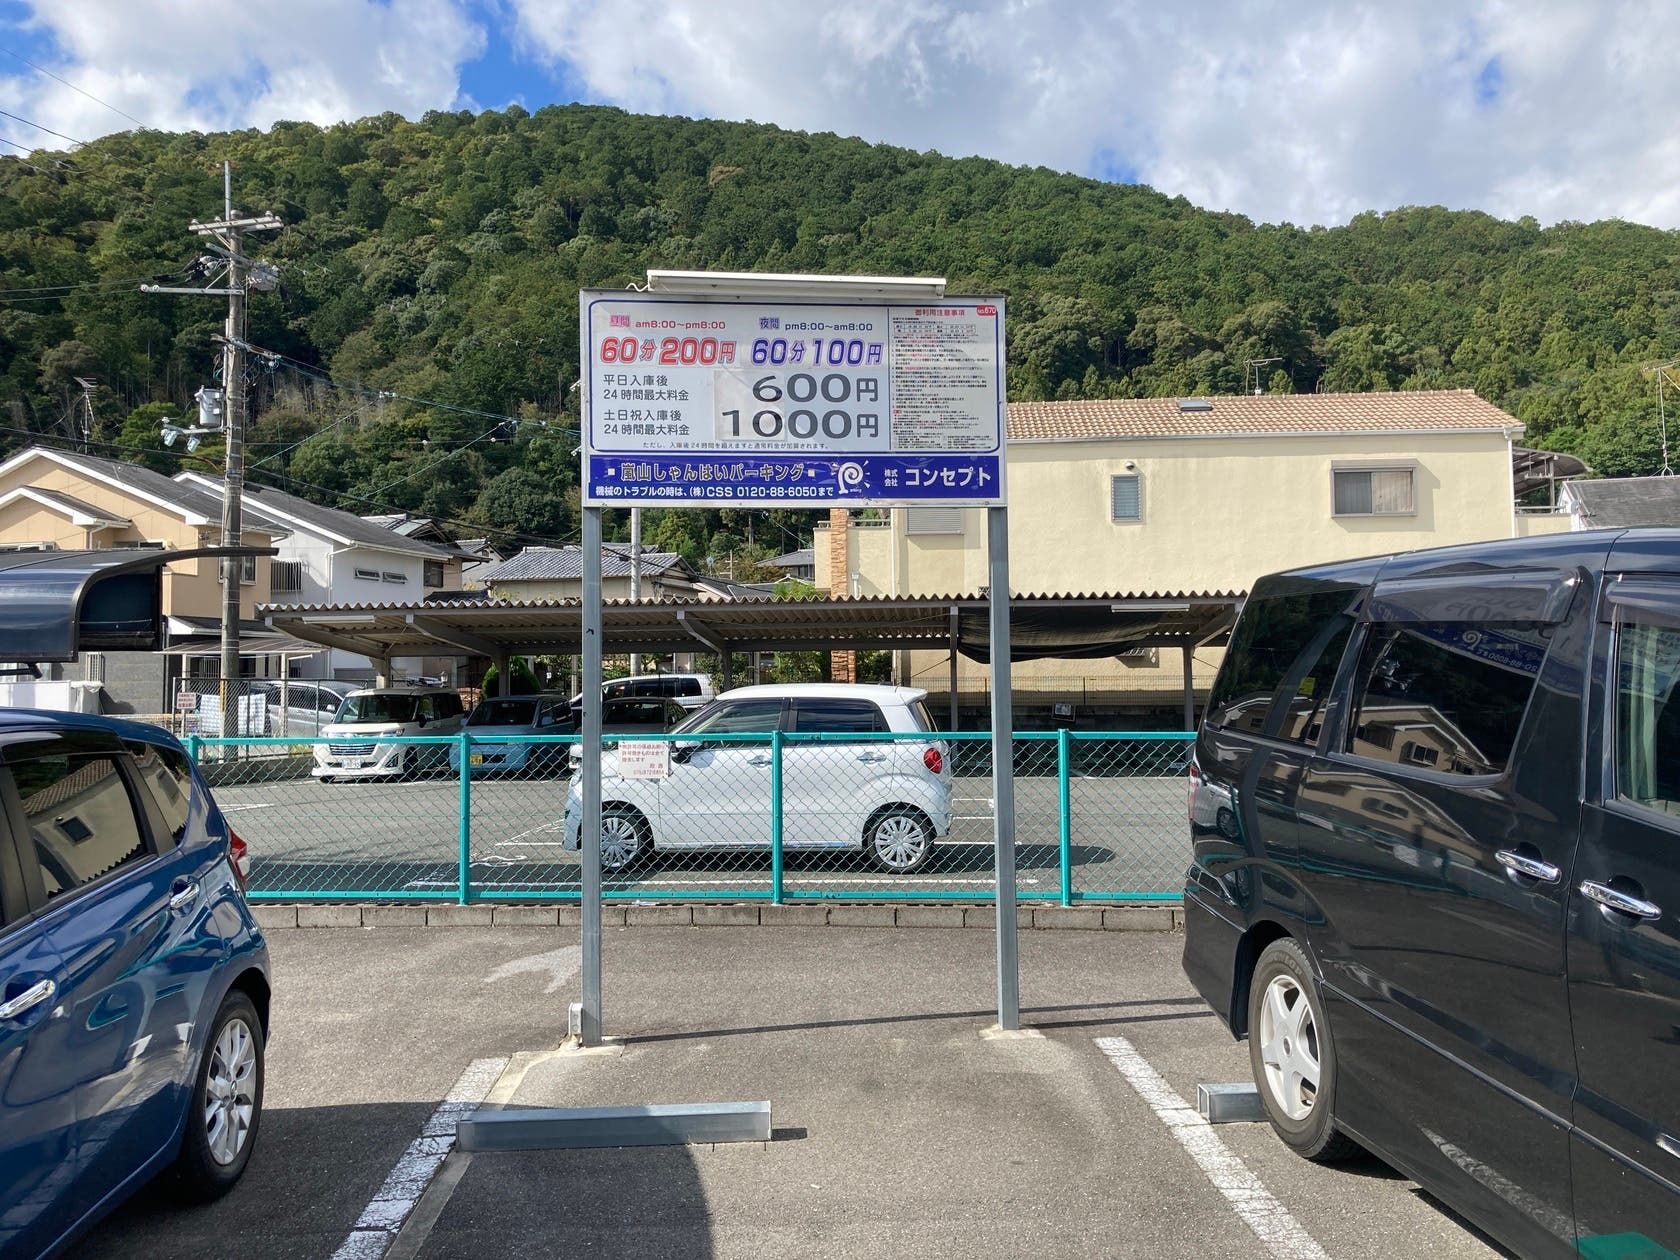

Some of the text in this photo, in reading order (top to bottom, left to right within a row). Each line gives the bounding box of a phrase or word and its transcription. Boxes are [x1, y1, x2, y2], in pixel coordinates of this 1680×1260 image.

[760, 316, 779, 329] 夜間
[603, 374, 668, 387] 平日入庫後
[752, 373, 879, 403] 600円
[603, 389, 689, 401] 24時間最大料金
[603, 409, 682, 421] 土日祝入庫後
[603, 424, 690, 436] 24時間最大料金
[721, 409, 879, 439] 1000円
[621, 463, 804, 482] 嵐山しゃんはいパーキング
[905, 466, 992, 487] コンセプト
